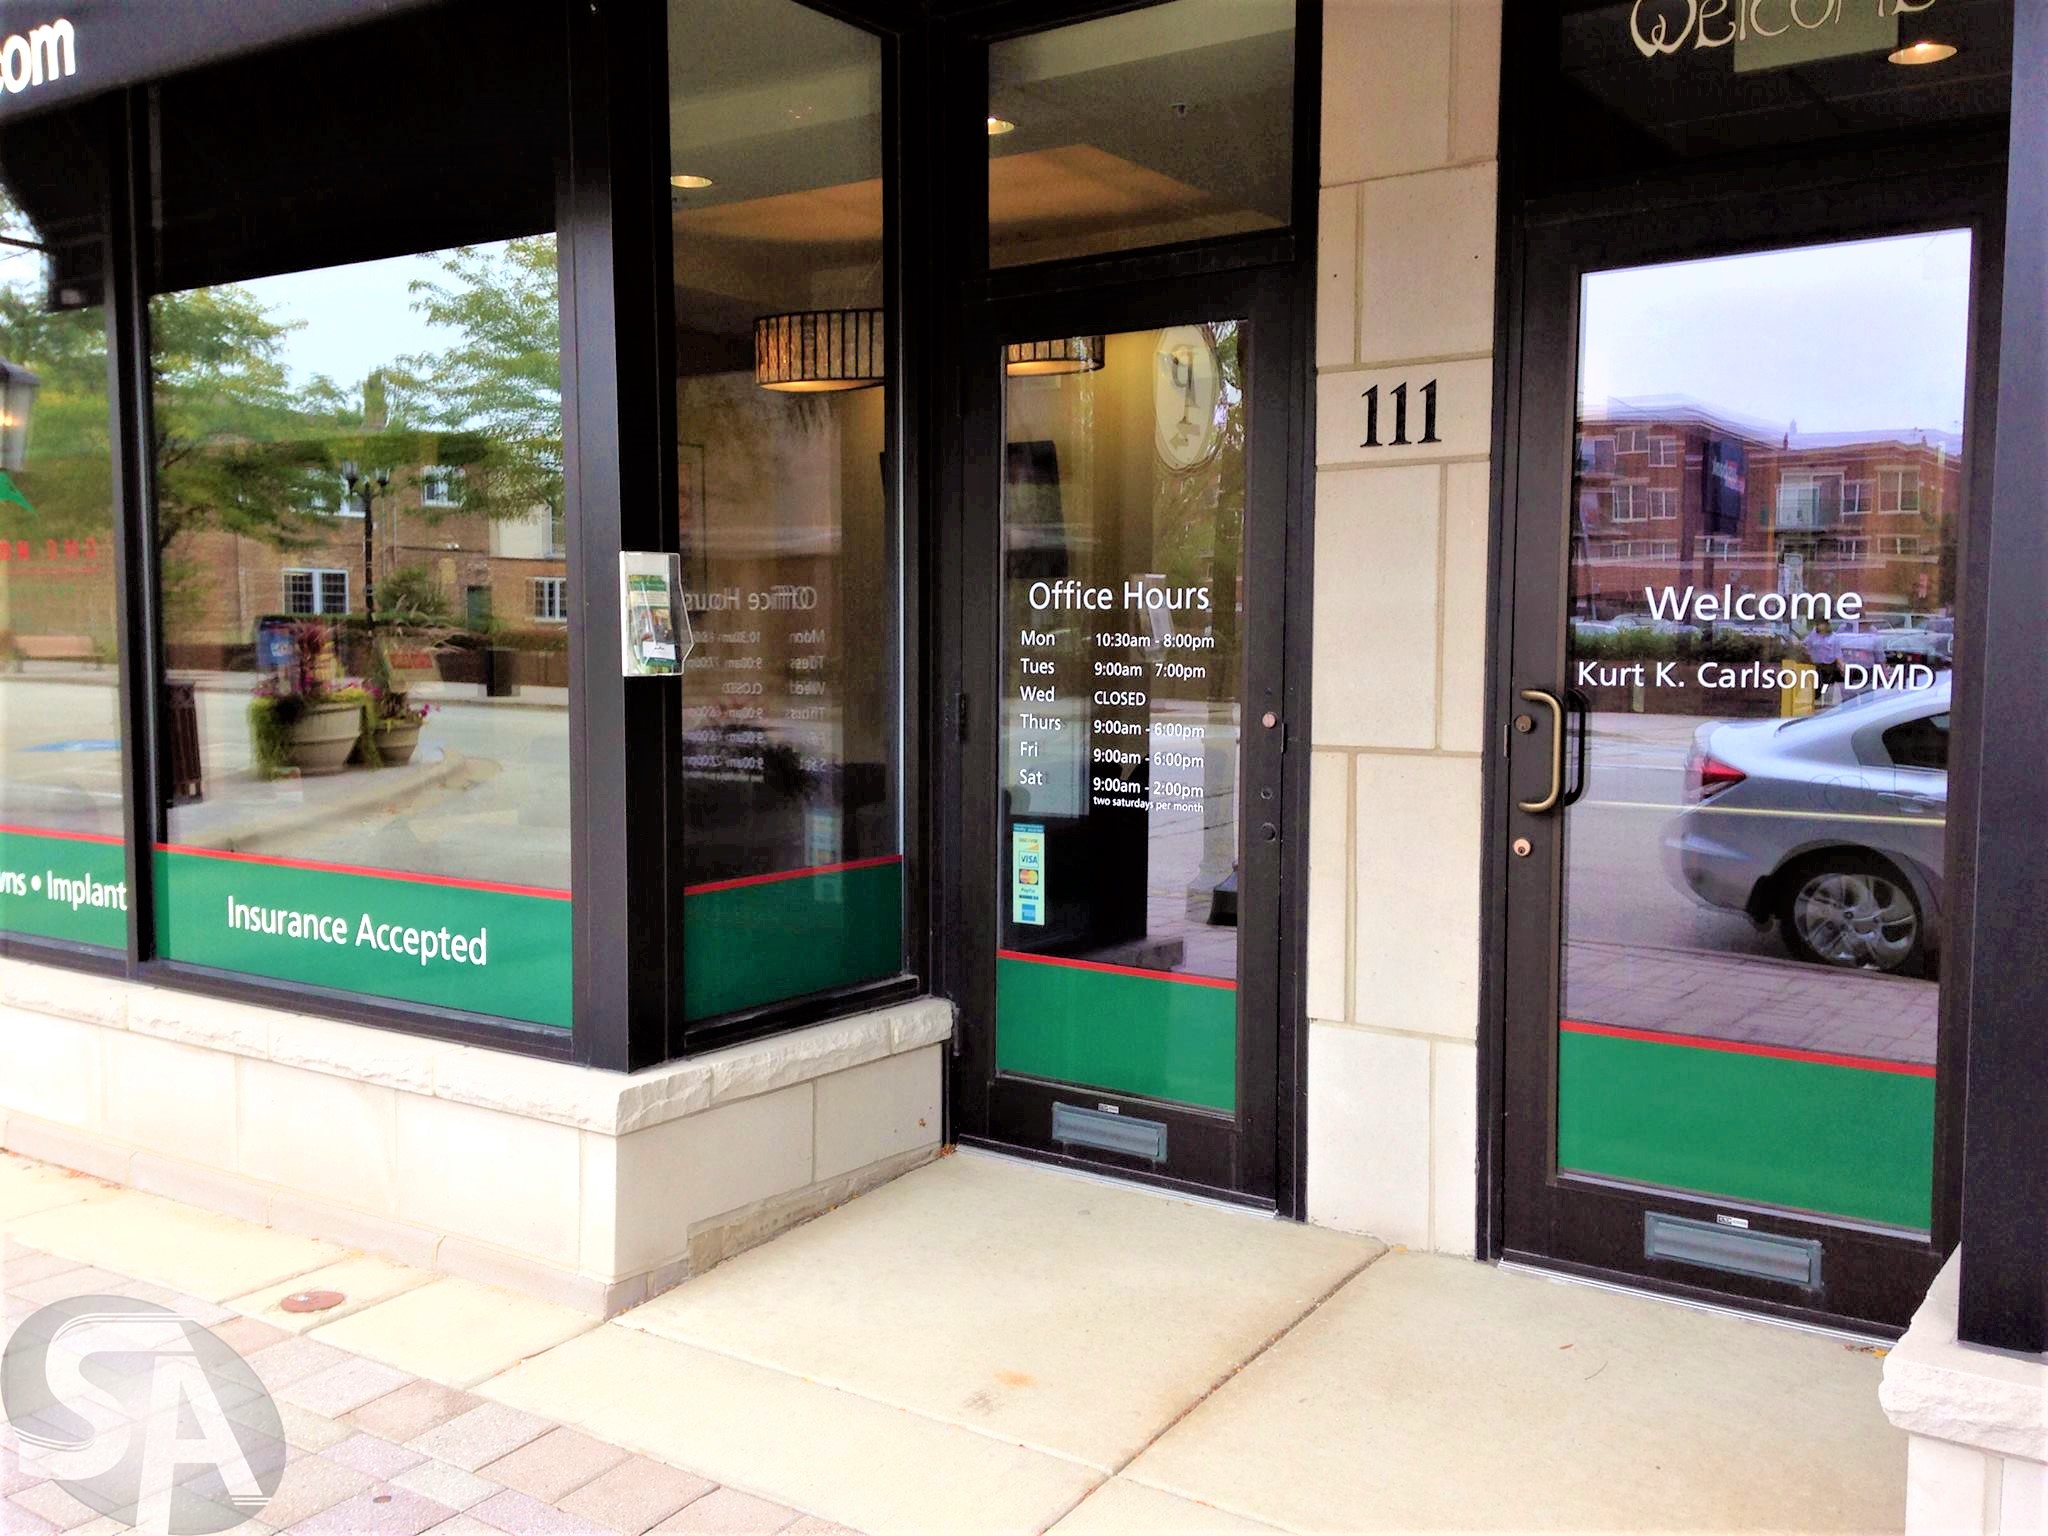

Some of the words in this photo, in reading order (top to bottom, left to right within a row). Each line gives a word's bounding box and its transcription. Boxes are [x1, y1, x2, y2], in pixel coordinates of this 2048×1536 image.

[0, 18, 76, 94] om
[1360, 379, 1442, 448] 111
[1029, 580, 1113, 610] Office
[1123, 582, 1209, 611] Hours
[1645, 584, 1863, 621] Welcome
[1020, 630, 1055, 646] Mon
[1096, 633, 1150, 648] 10:30am
[1163, 634, 1215, 651] 8:00pm
[1020, 658, 1055, 675] Tues
[1094, 662, 1142, 677] 9:00am
[1155, 663, 1206, 681] 7:00pm
[1577, 661, 1645, 687] Kurt
[1656, 662, 1685, 688] K.
[1697, 661, 1829, 695] Carlson,
[1844, 663, 1935, 691] DMD
[1020, 686, 1055, 702] Wed
[1094, 691, 1146, 706] CLOSED
[1020, 714, 1061, 731] Thurs
[1093, 720, 1142, 735] 9:00am
[1154, 723, 1205, 740] 6:00pm
[1020, 742, 1038, 757] Fri
[1093, 749, 1142, 764] 9:00am
[1154, 752, 1204, 769] 6:00pm
[1020, 769, 1043, 786] Sat
[1093, 778, 1141, 794] 9:00am
[1153, 781, 1204, 799] 2:00pm
[1093, 796, 1111, 806] two
[1112, 798, 1154, 811] saturdays
[1156, 801, 1171, 812] per
[1173, 803, 1204, 813] month
[1021, 855, 1038, 864] VISA
[47, 869, 127, 911] Implant
[228, 895, 348, 944] Insurance
[356, 913, 487, 966] Accepted
